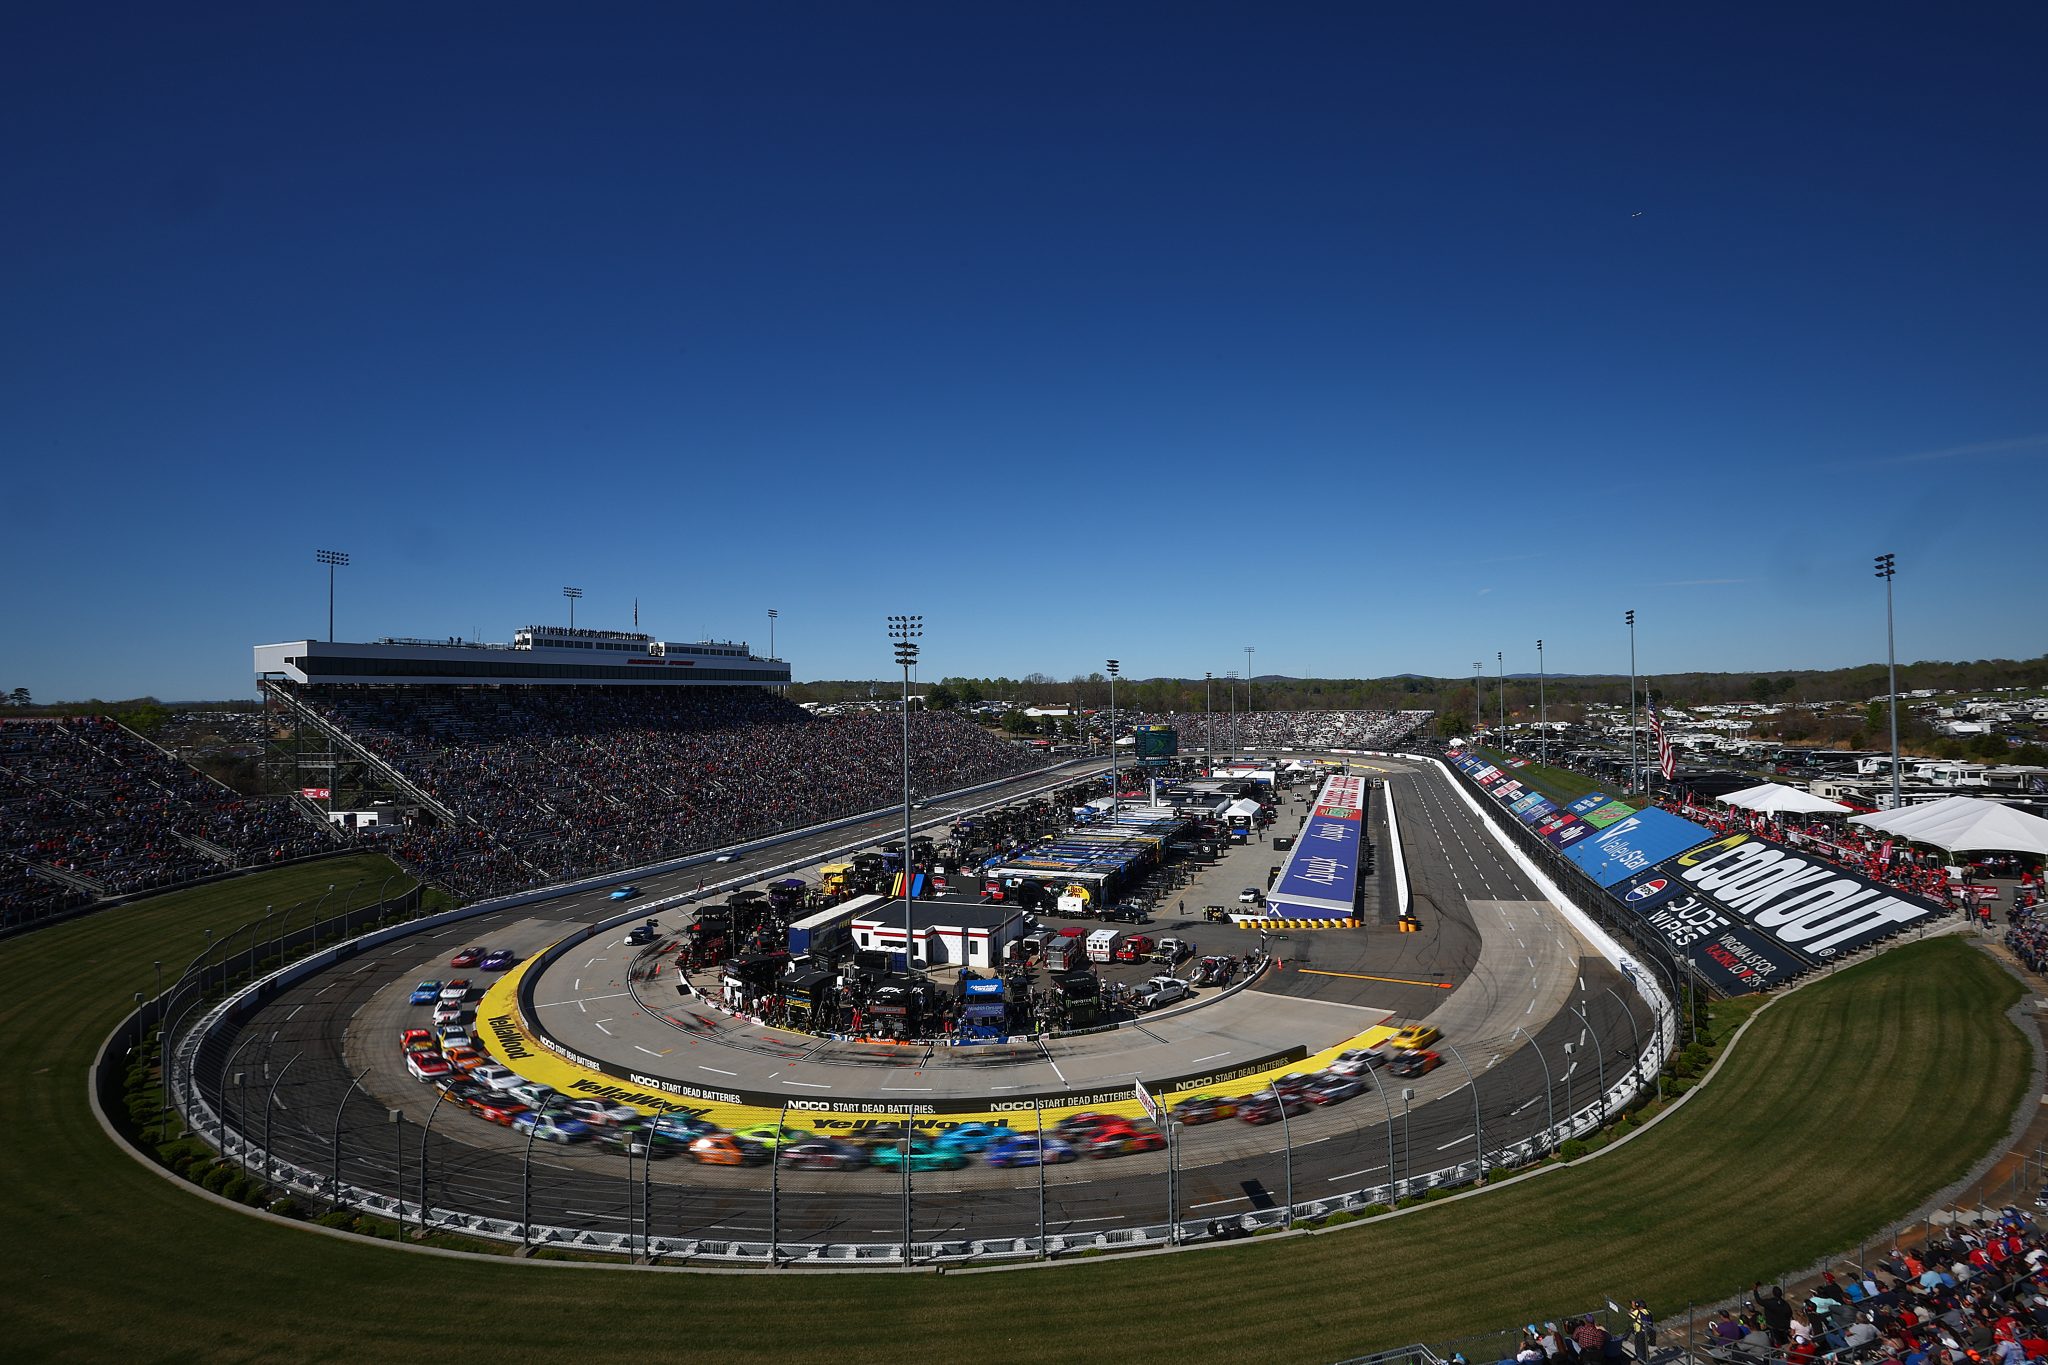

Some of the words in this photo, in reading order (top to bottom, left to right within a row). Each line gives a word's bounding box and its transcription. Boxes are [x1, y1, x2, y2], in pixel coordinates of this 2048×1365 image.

[1648, 909, 1698, 946] WIPES
[1668, 896, 1731, 936] DUDE
[1718, 933, 1753, 960] VIRGINIA
[1750, 959, 1776, 976] FOR
[488, 1015, 534, 1059] YellaWood
[540, 1035, 555, 1051] NOCO
[555, 1044, 566, 1057] START
[567, 1050, 577, 1062] DEAD
[630, 1073, 659, 1089] NOCO
[661, 1083, 681, 1094] START
[683, 1087, 700, 1098] DEAD
[702, 1090, 742, 1104] BATTERIES.
[1176, 1077, 1212, 1091] NOCO
[1215, 1071, 1236, 1084] START
[1238, 1066, 1255, 1079] DEAD
[788, 1100, 829, 1111] NOCO
[833, 1102, 859, 1112] START
[861, 1103, 885, 1113] DEAD
[887, 1104, 936, 1114] BATTERIES.
[991, 1101, 1034, 1112] NOCO
[1038, 1098, 1065, 1110] START
[1067, 1096, 1090, 1107] DEAD
